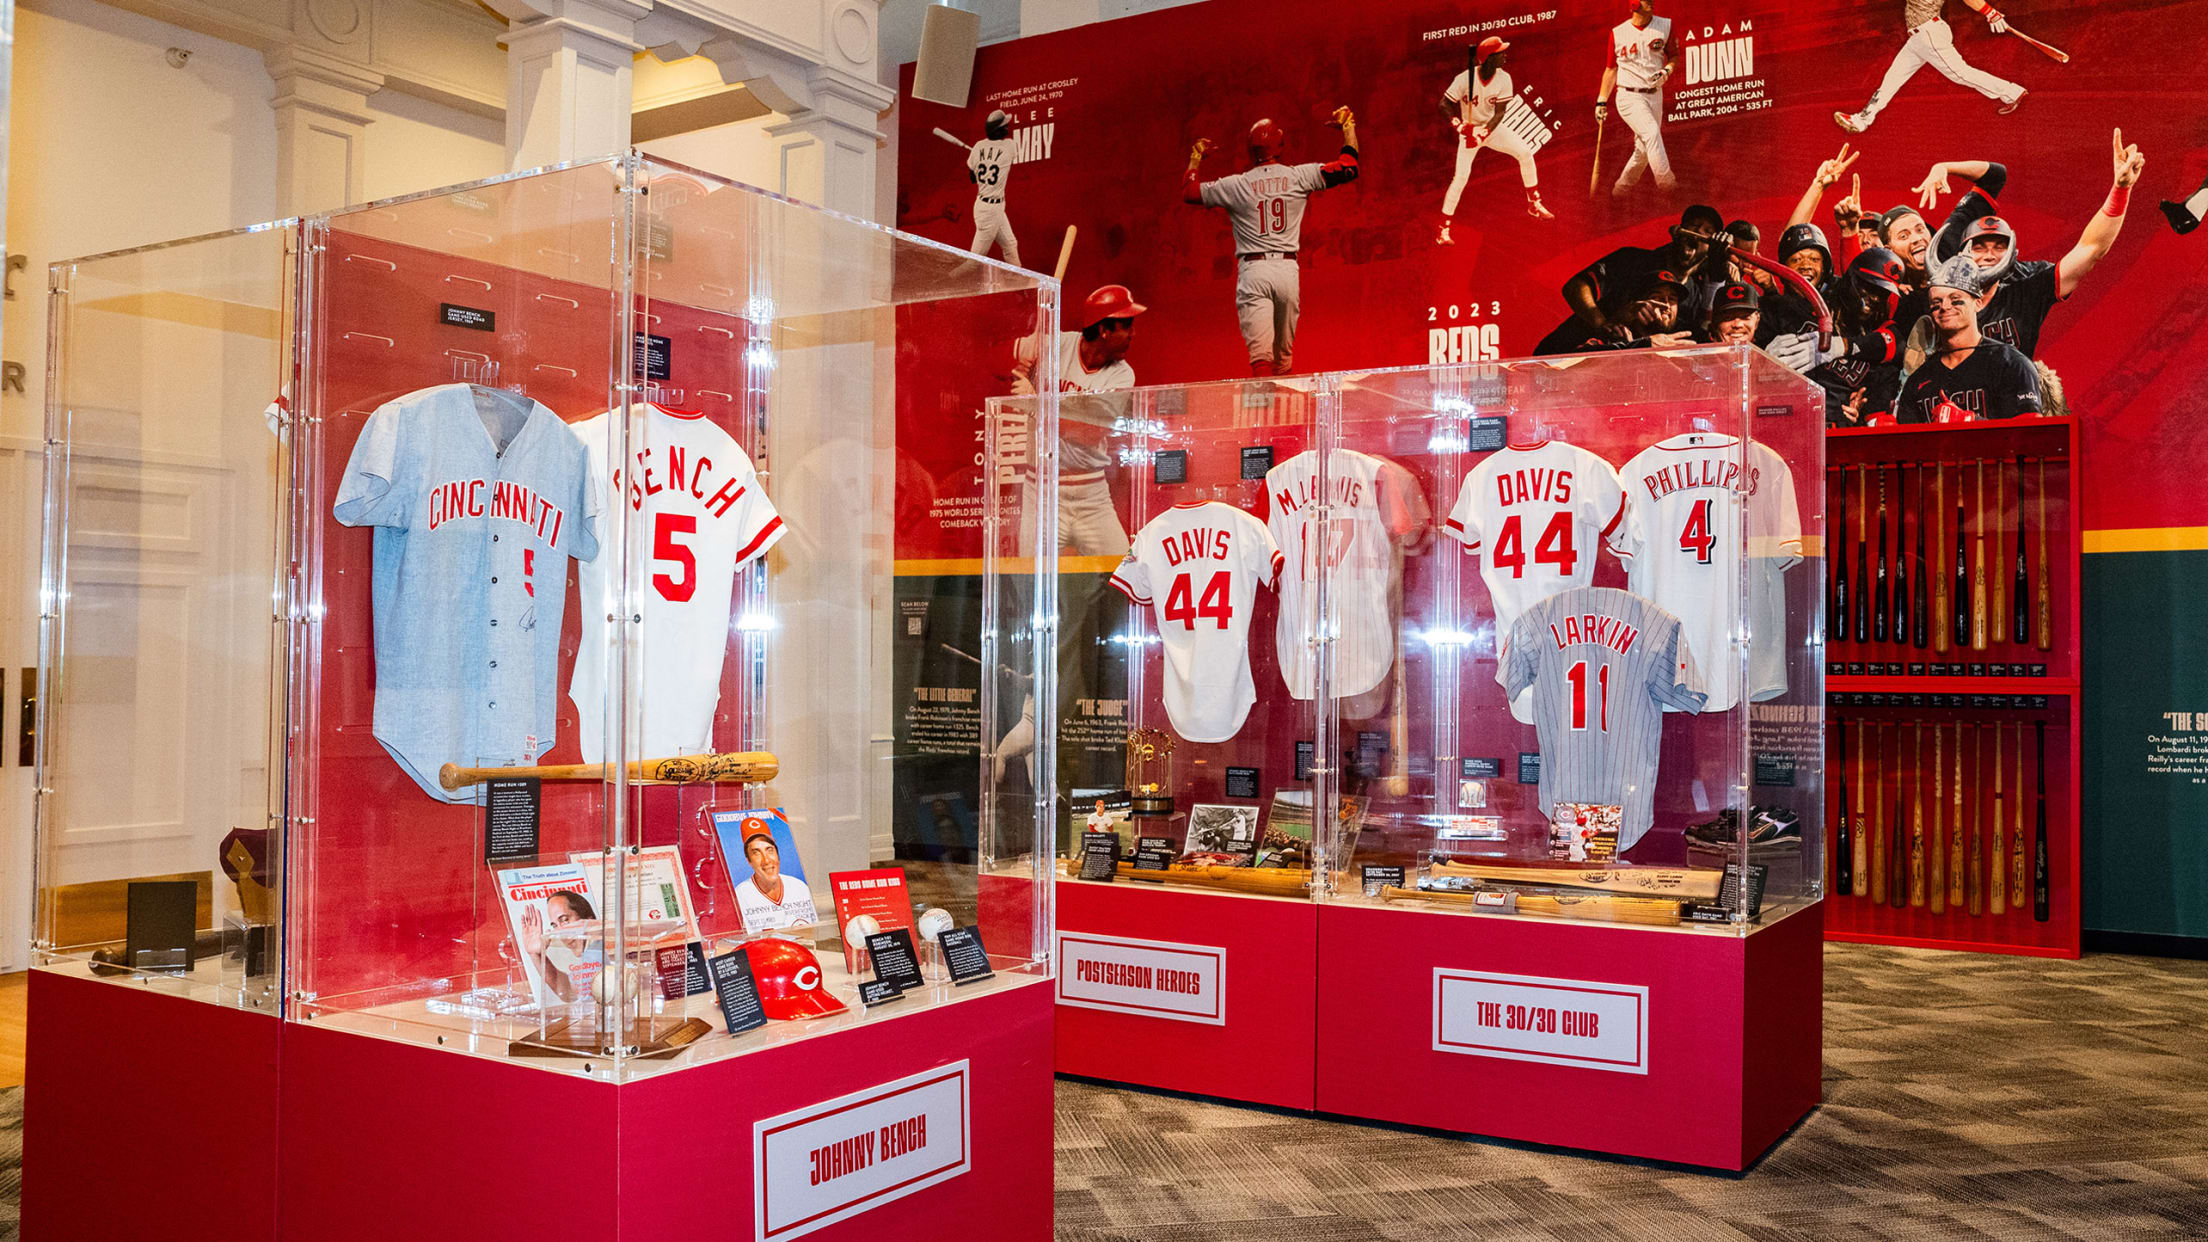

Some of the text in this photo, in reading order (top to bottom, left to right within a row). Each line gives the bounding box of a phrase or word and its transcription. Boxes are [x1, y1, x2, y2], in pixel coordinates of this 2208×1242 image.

[1422, 10, 1557, 41] FIRST RED IN 30/30 CLUB, 1987
[1686, 20, 1752, 41] ADAM
[1620, 42, 1638, 58] 44
[1686, 36, 1753, 86] DUNN
[986, 78, 1078, 102] LAST HOME RUN AT CROSLEY
[1000, 99, 1020, 108] FIELD,
[1020, 94, 1037, 105] JUNE
[1049, 90, 1064, 100] 1970
[1675, 79, 1765, 100] LONGEST HOME RUN
[1676, 90, 1764, 110] AT GREAT AMERICAN
[1014, 108, 1054, 124] LEE
[1523, 84, 1562, 130] ERIC
[1668, 99, 1773, 122] BALL PARK, 2004 535 FT
[1501, 93, 1553, 151] DAVIS
[1012, 122, 1054, 165] MAY
[978, 163, 1000, 186] 23
[1250, 176, 1288, 196] VOTTO
[1256, 197, 1287, 238] 19
[1726, 286, 1744, 300] C
[1428, 301, 1500, 320] 2023
[1429, 324, 1500, 384] REDS
[974, 409, 985, 486] TONY
[1496, 468, 1572, 507] DAVIS
[930, 508, 970, 518] 1975 WORLD
[933, 498, 954, 507] HOME
[956, 496, 970, 506] RUN
[972, 496, 980, 504] IN
[940, 520, 978, 528] COMEBACK
[1680, 498, 1717, 565] 4
[652, 512, 696, 603] 5
[1162, 528, 1230, 568] DAVIS
[1494, 511, 1578, 580] 44
[1164, 571, 1233, 631] 44
[1550, 614, 1639, 656] LARKIN
[1566, 660, 1610, 735] 11
[2157, 745, 2191, 753] Lombardi
[2162, 735, 2187, 745] August
[2148, 754, 2173, 765] Reilly's
[510, 881, 588, 902] Cinciti
[792, 966, 819, 991] C
[1077, 958, 1200, 996] POSTSEASON HEROES
[1476, 1001, 1600, 1040] THE 30/30 CLUB
[810, 1113, 927, 1187] JOHNNY BENCH
